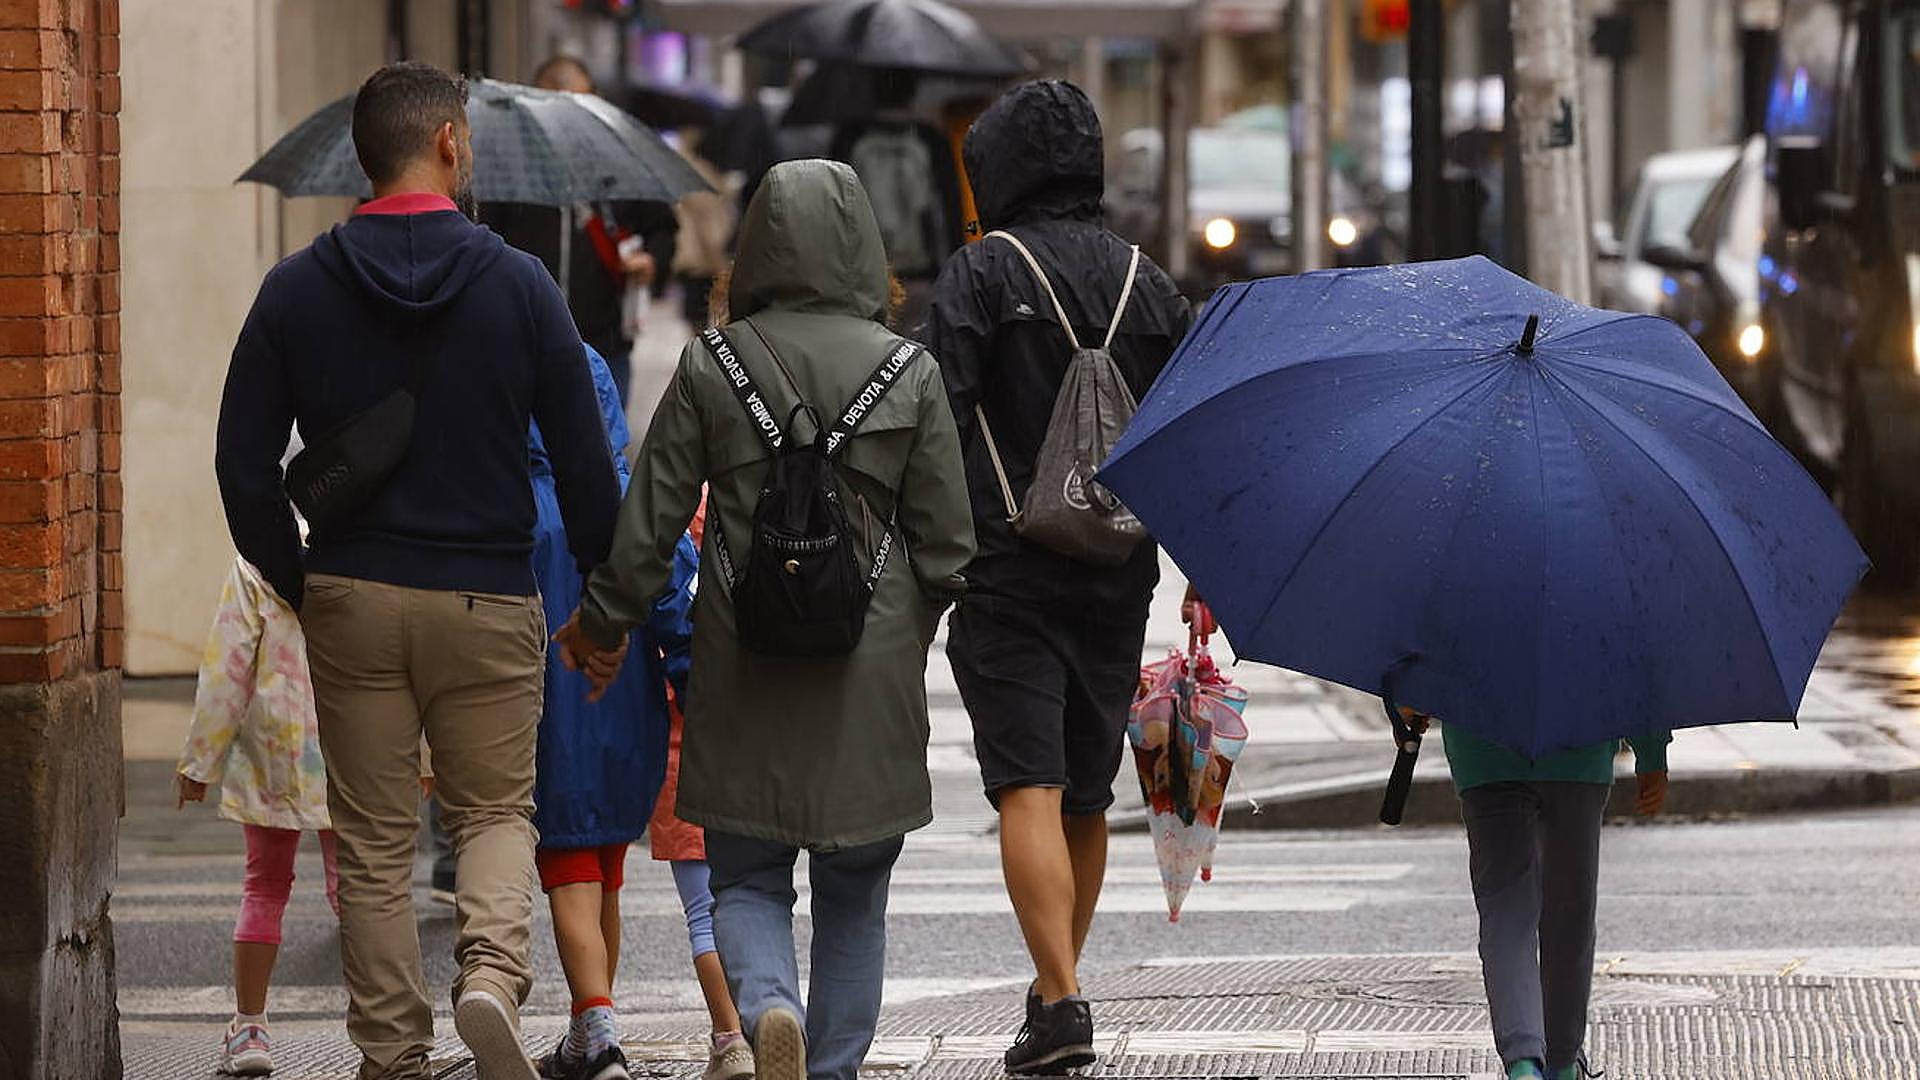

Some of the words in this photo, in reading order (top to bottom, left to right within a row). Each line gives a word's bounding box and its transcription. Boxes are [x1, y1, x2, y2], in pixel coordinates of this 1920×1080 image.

[716, 343, 750, 388] DEVOTA
[842, 381, 885, 427] DEVOTA
[879, 368, 894, 382] &
[887, 342, 918, 374] LOMBA
[746, 391, 780, 438] LOMBA
